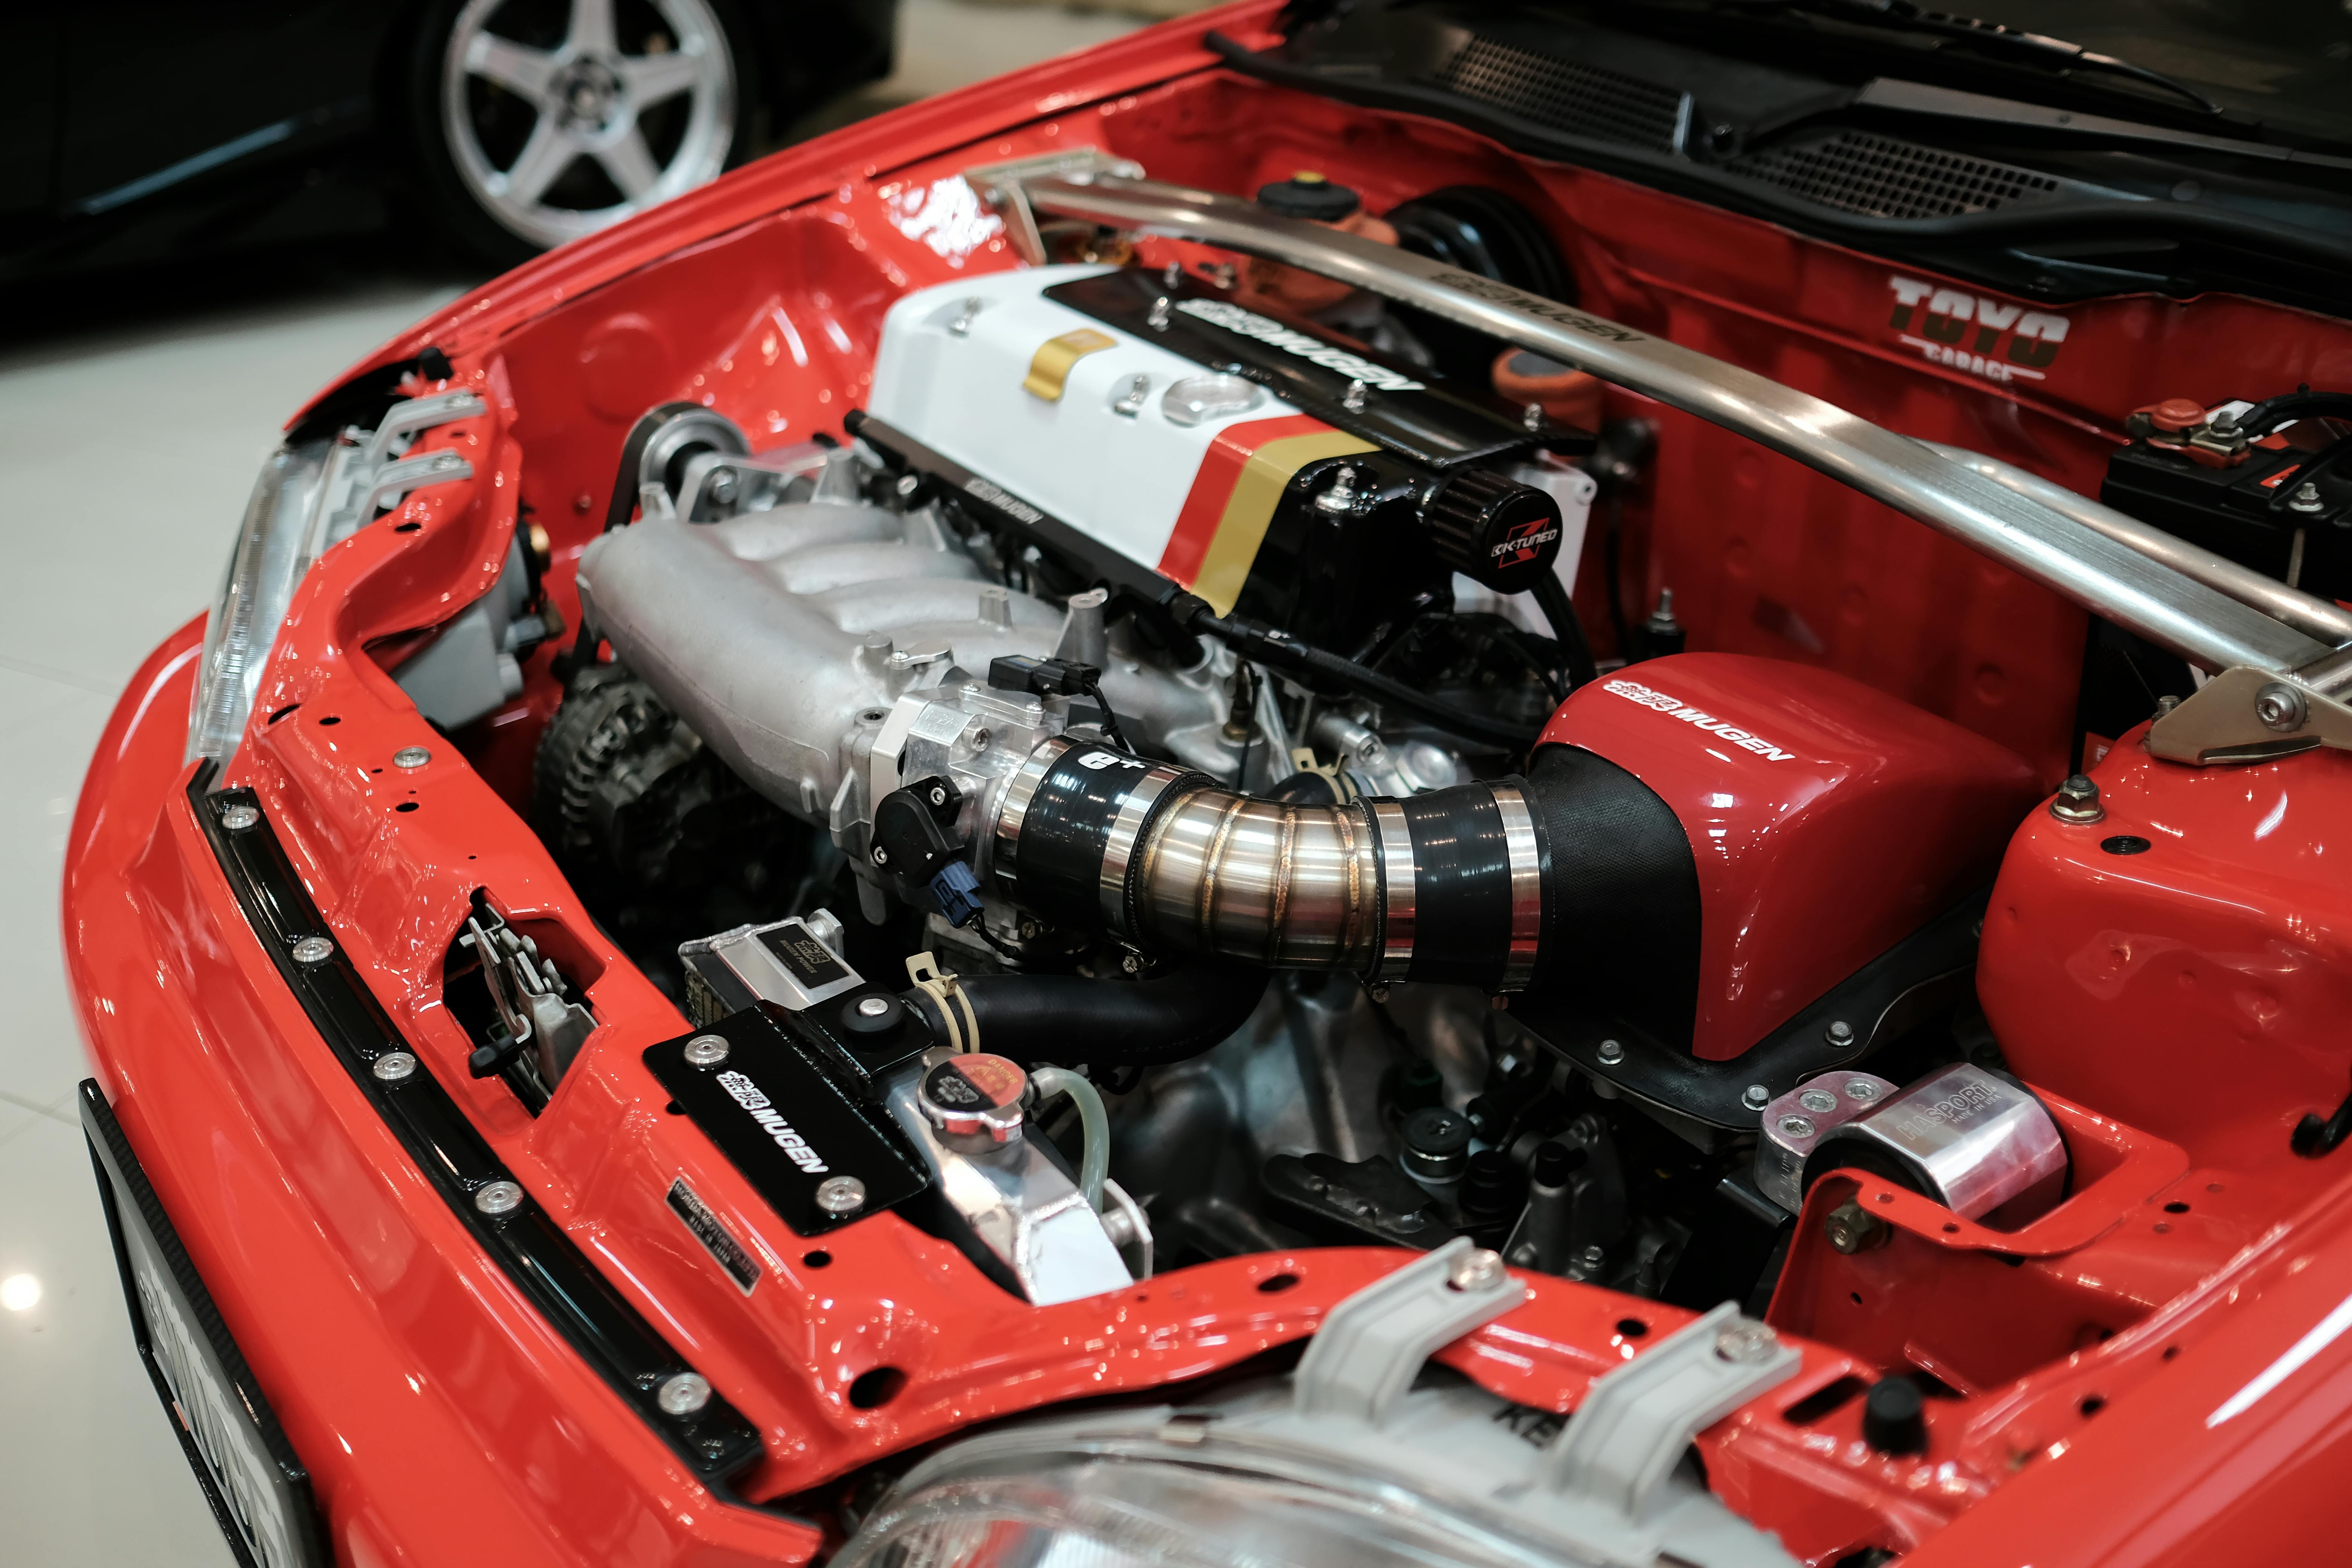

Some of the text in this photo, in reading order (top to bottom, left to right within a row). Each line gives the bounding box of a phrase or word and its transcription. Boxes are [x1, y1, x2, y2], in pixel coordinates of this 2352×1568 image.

[1508, 299, 1646, 341] MUGEN
[1889, 275, 2070, 368] TOYO
[1257, 329, 1427, 390] MUGEN
[1668, 708, 1796, 761] MUGEN
[779, 940, 799, 959] MUGEN
[796, 956, 818, 974] POWER
[988, 1059, 1018, 1085] DANGER
[1896, 1079, 1993, 1141] HASPORT
[1952, 1094, 2002, 1124] MADE IN USA
[750, 1108, 829, 1173] MUGEN
